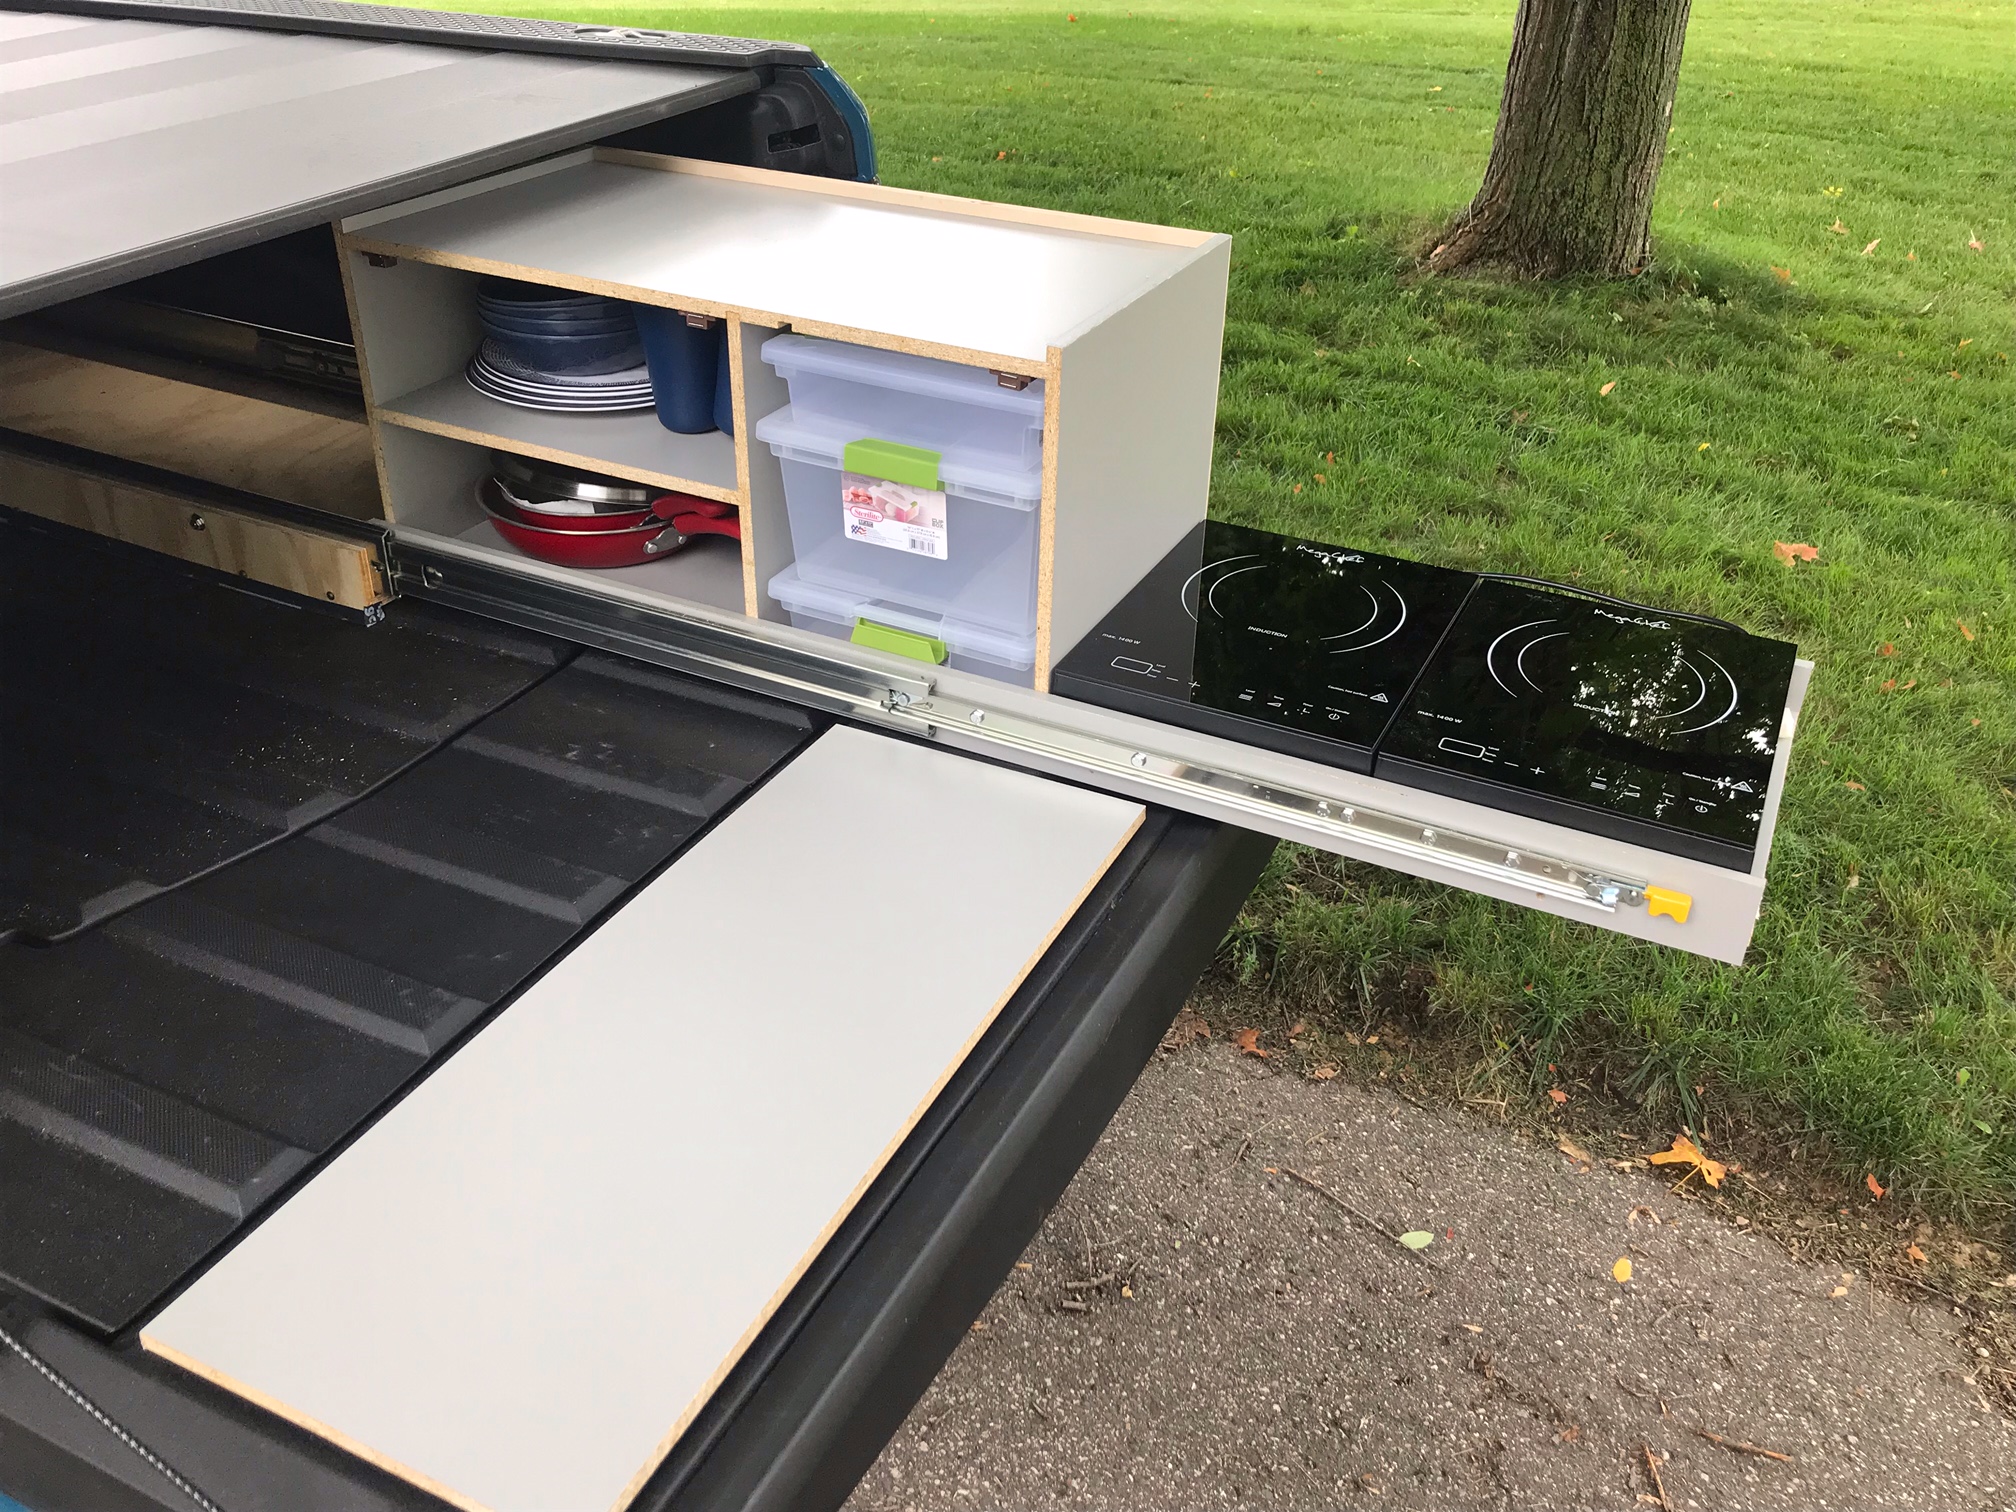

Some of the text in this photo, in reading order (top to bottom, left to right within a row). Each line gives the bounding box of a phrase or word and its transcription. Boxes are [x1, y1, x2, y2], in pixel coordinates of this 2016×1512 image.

[854, 508, 881, 520] Sterilite
[1247, 625, 1288, 639] INDUCTION
[1436, 714, 1454, 722] 1400
